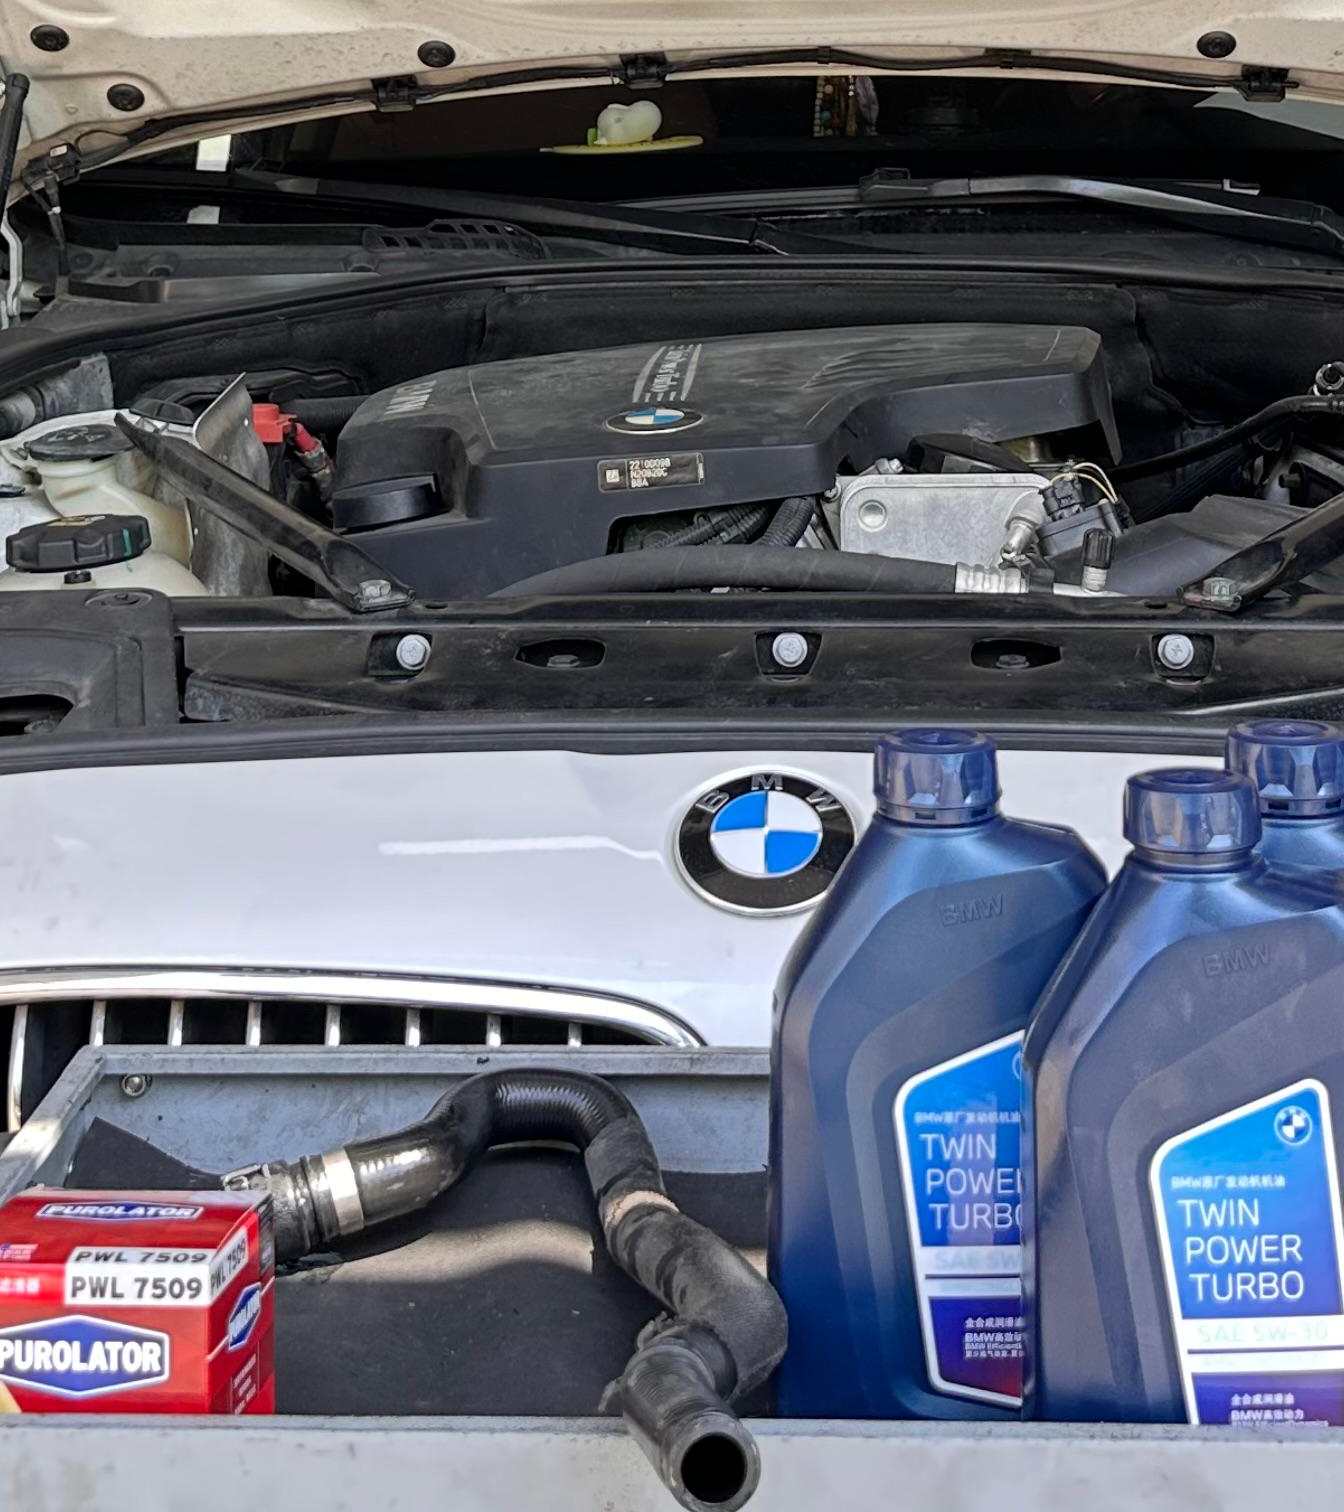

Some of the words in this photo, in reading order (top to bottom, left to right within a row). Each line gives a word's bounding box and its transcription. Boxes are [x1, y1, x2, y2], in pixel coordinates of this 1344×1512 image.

[695, 773, 843, 814] BMW
[940, 893, 1004, 927] BMW
[1202, 943, 1271, 978] BMW
[919, 1133, 997, 1161] TWIN
[926, 1167, 1022, 1196] POWE
[47, 1203, 195, 1217] PUROLATOR
[1176, 1198, 1260, 1228] TWIN
[75, 1251, 128, 1264] PWL
[139, 1251, 206, 1263] 7509
[1185, 1234, 1304, 1266] POWER
[71, 1276, 124, 1299] PWL
[134, 1277, 202, 1299] 7509
[1189, 1270, 1304, 1303] TURBO
